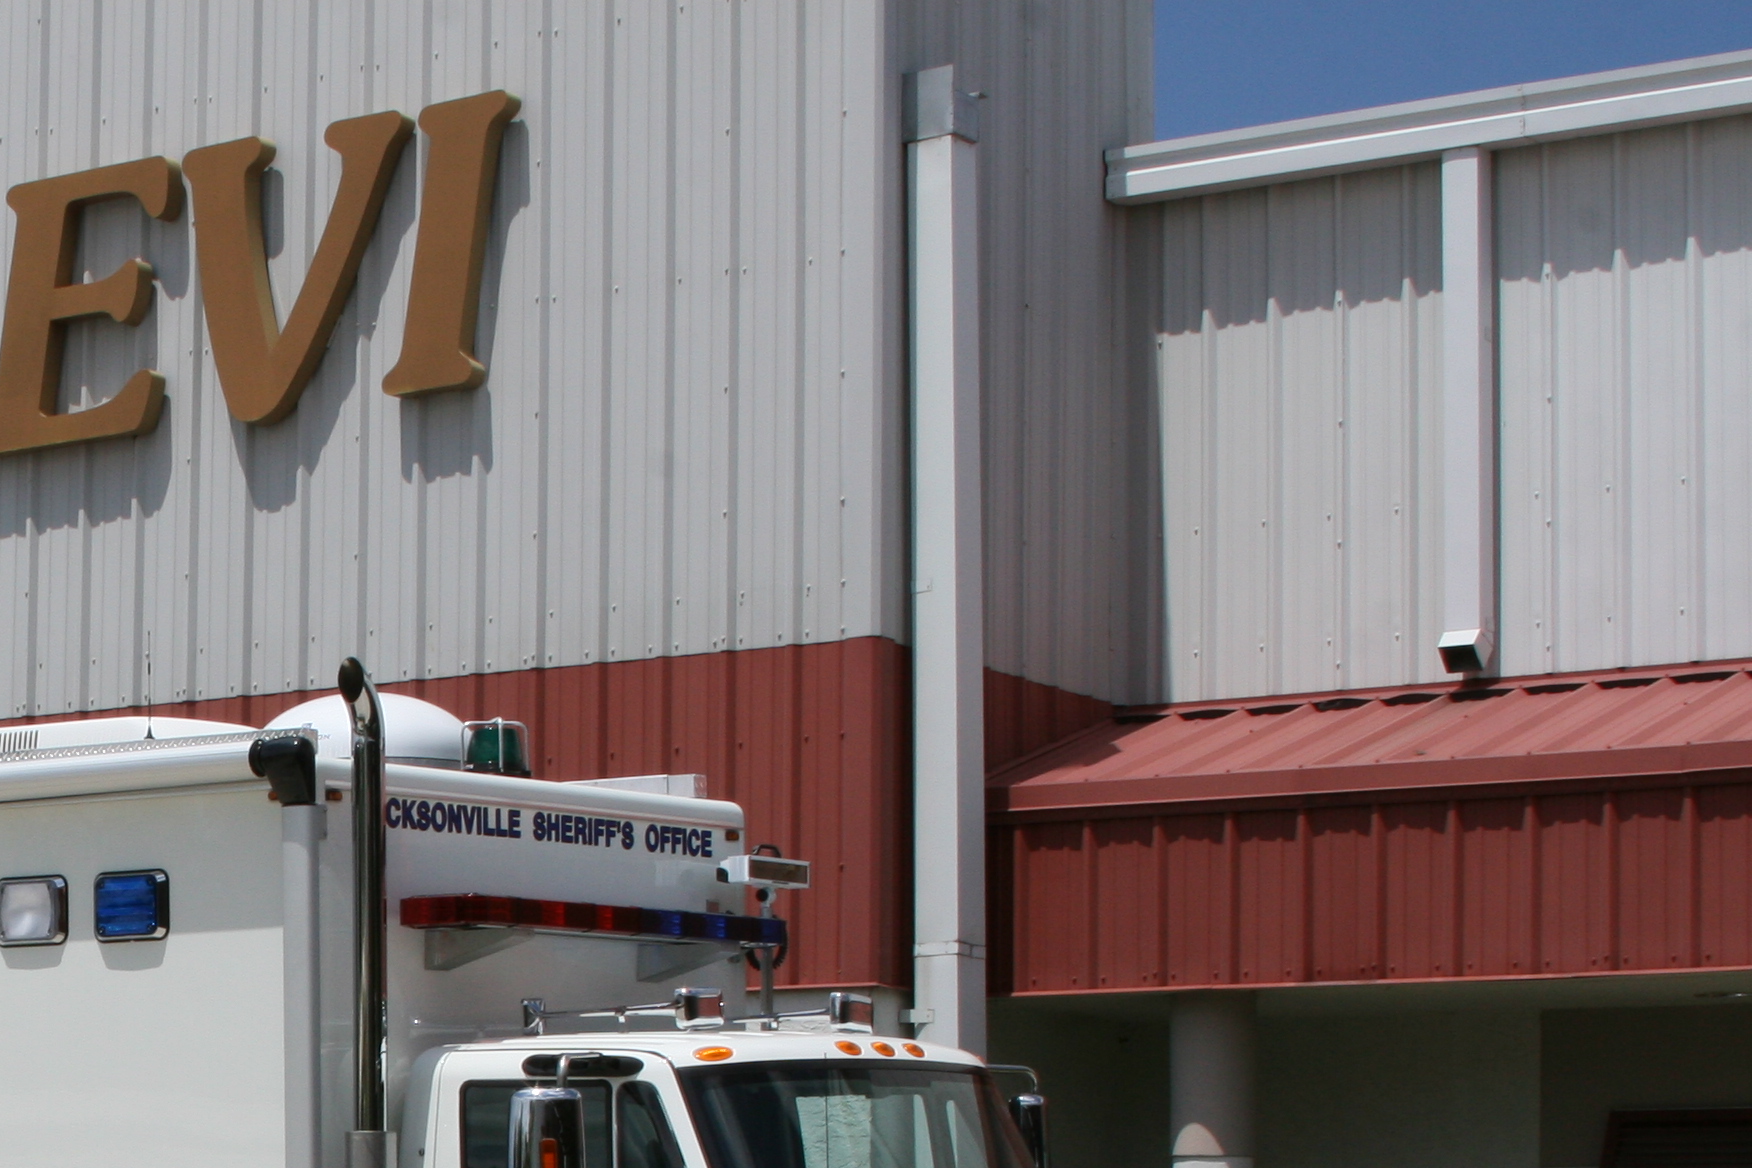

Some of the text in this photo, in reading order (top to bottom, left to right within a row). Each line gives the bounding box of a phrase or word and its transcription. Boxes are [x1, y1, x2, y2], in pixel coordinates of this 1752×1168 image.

[385, 798, 713, 857] CKSONVILLE SHERIFF'S OFFICE
